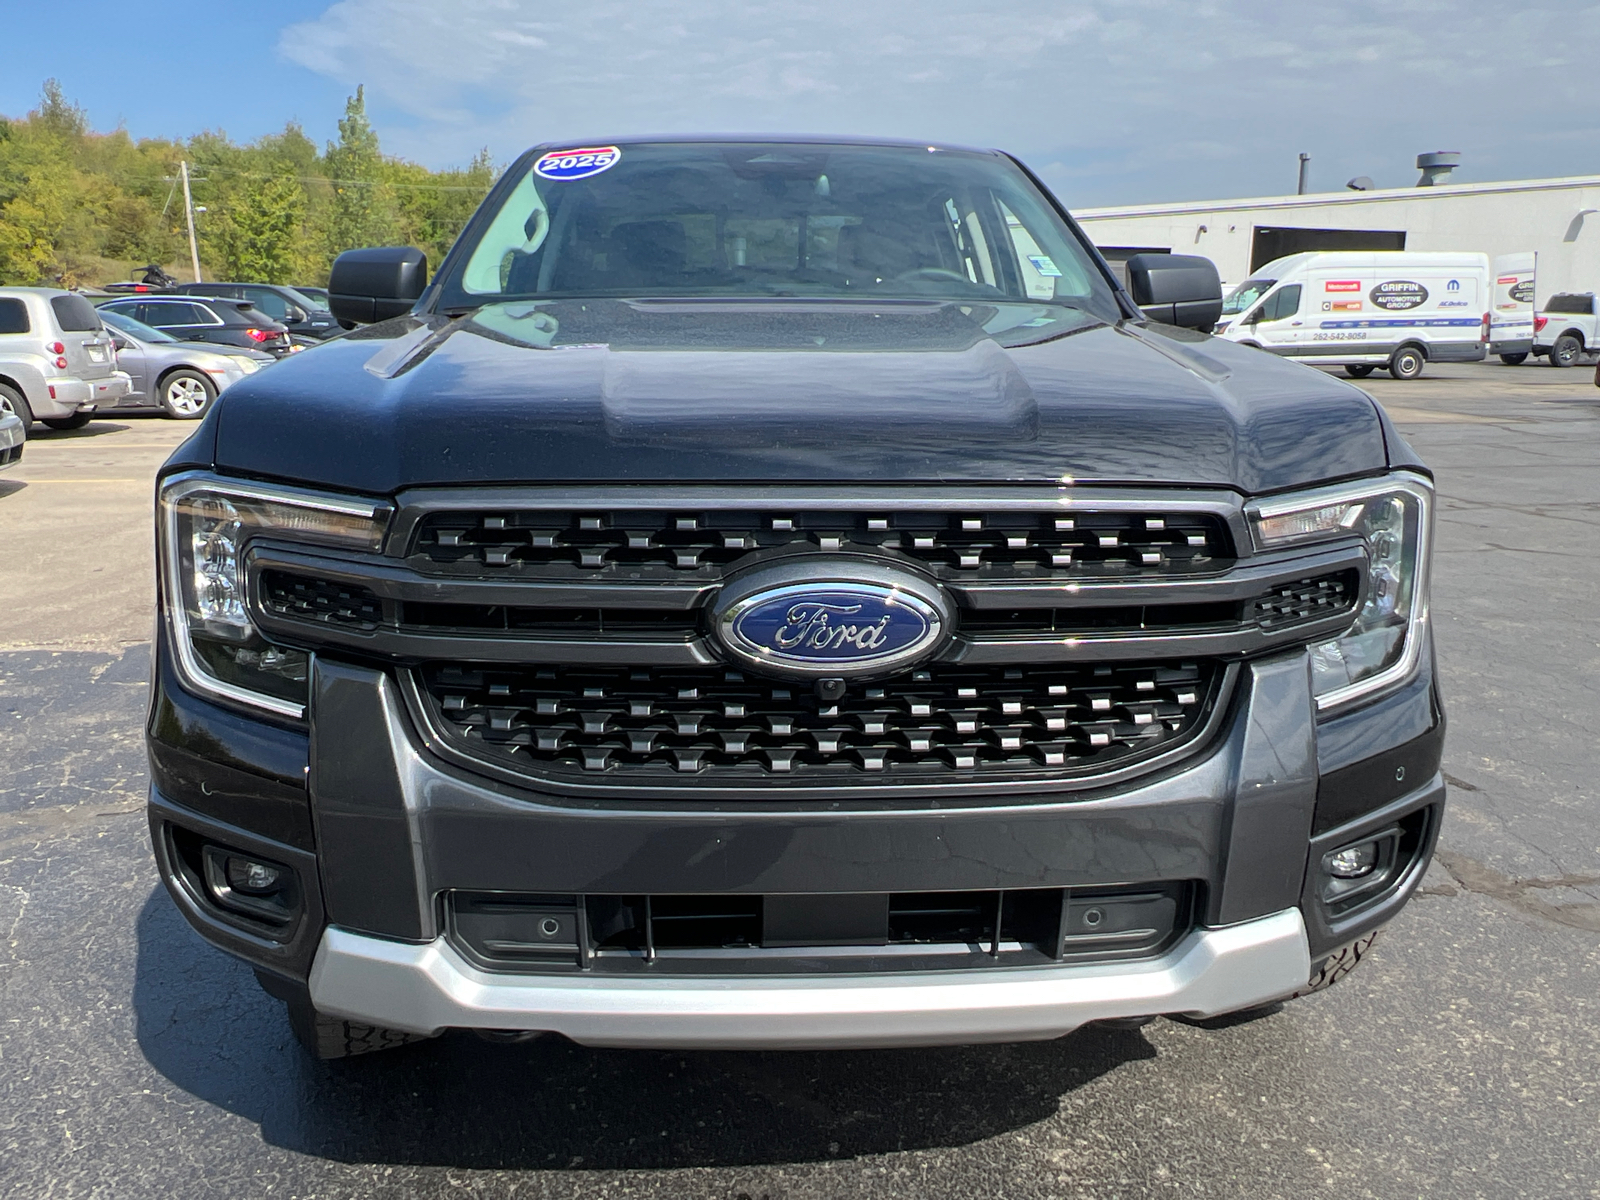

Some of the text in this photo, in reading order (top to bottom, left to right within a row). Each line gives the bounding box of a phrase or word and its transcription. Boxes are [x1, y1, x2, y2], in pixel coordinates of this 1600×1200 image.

[541, 154, 613, 171] 2025
[1381, 283, 1419, 293] GRIFFIN
[1377, 296, 1421, 304] AUTOMOTIVE
[774, 602, 891, 650] Ford
